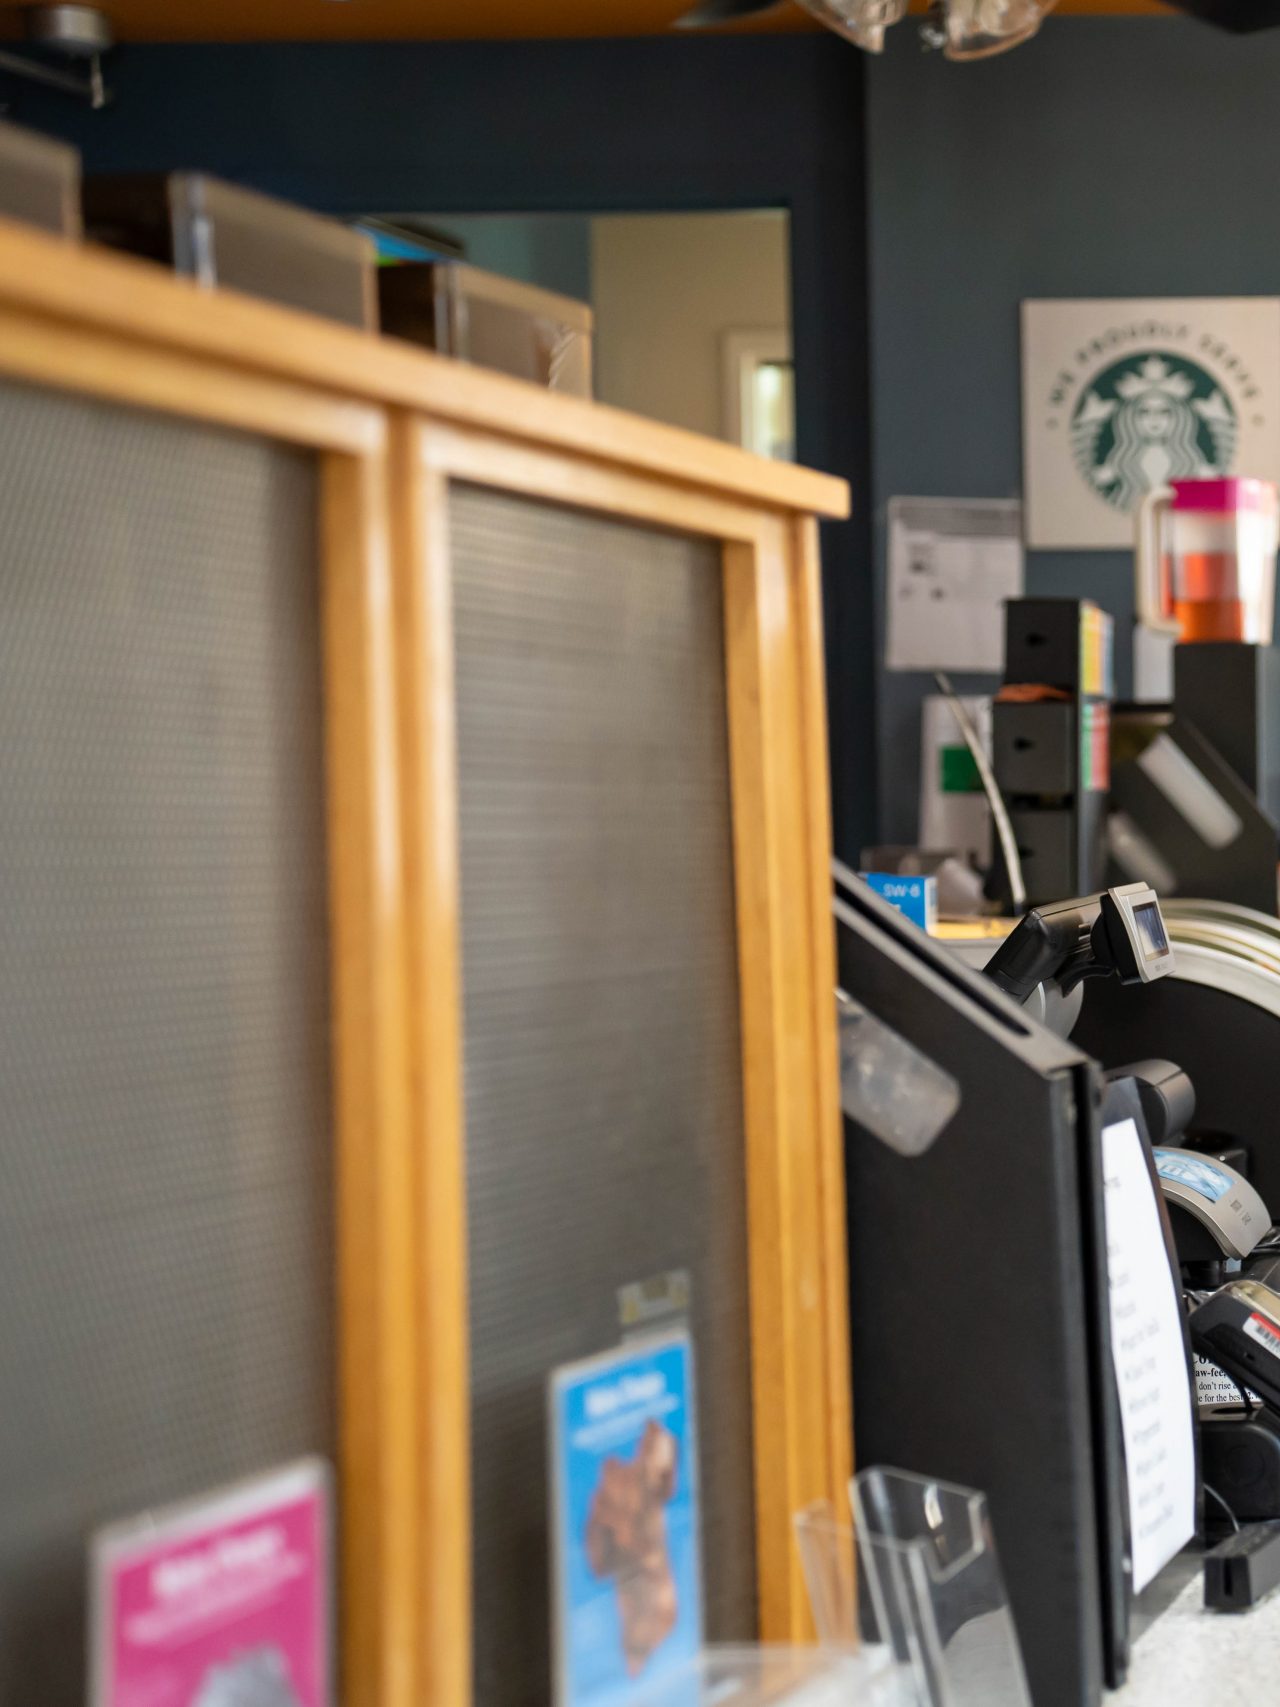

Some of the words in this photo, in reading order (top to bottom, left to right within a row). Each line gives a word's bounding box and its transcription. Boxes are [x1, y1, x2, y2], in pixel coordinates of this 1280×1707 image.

[1195, 1367, 1227, 1379] aw-fee,
[1204, 1393, 1215, 1403] for
[1216, 1394, 1228, 1403] the
